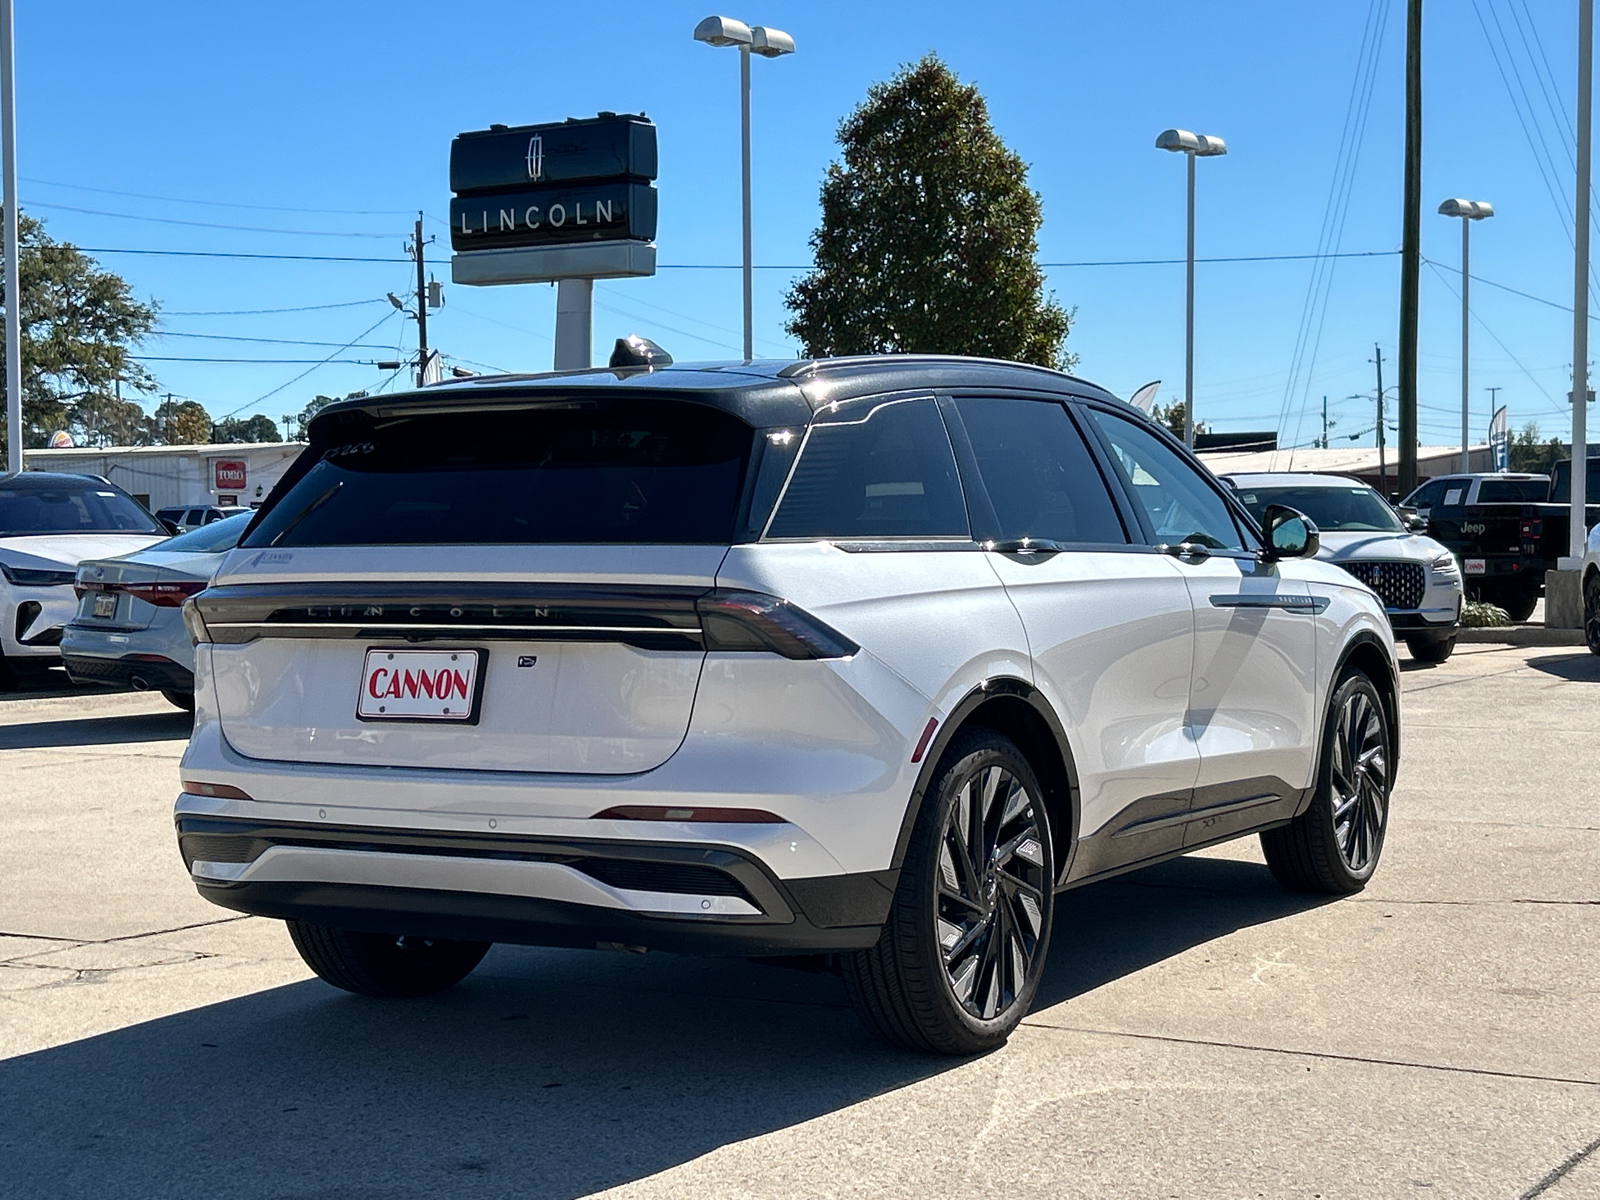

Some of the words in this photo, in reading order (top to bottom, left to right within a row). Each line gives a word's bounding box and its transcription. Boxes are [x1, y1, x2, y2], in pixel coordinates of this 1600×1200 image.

[461, 200, 613, 234] LINCOLN
[218, 470, 244, 480] TORO
[1460, 521, 1486, 536] Jeep
[307, 606, 549, 618] LINCOLN
[369, 668, 470, 700] CANNON
